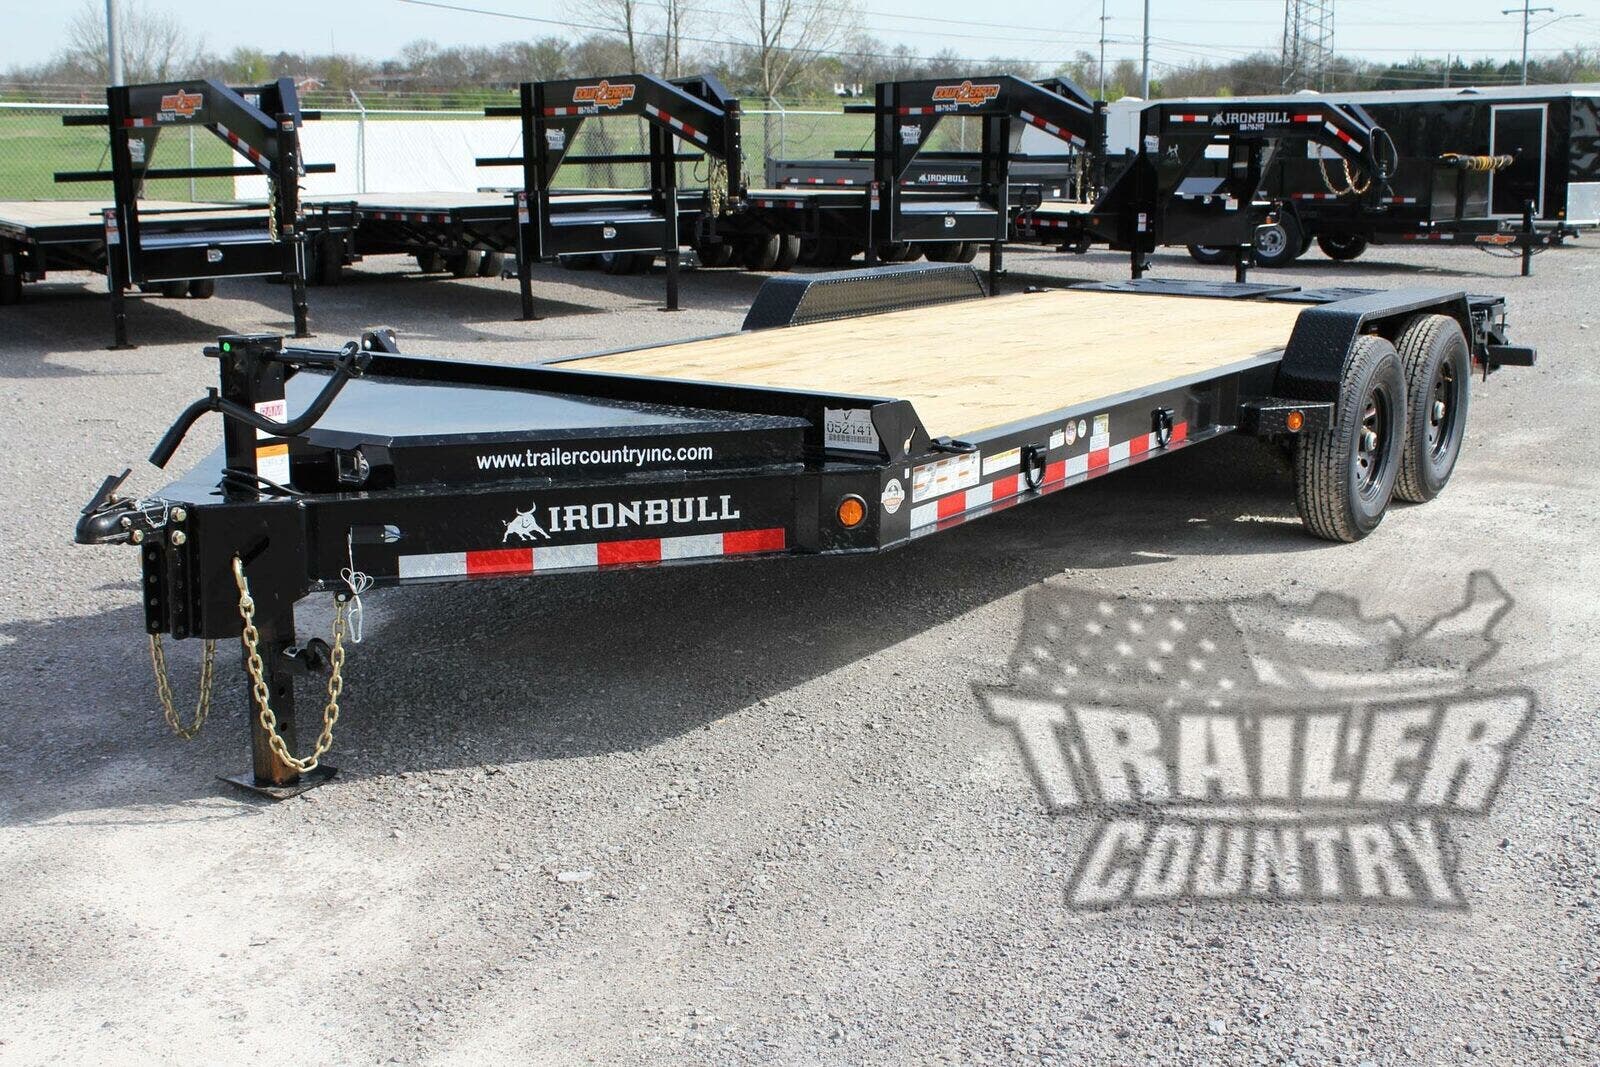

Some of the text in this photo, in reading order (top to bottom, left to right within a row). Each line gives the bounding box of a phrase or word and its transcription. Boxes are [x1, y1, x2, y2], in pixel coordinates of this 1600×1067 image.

[1226, 112, 1290, 123] IRONBULL
[927, 174, 968, 182] IRONBULL
[826, 420, 872, 436] 052141
[476, 446, 713, 470] www.trailercountryinc.com
[548, 494, 741, 533] IRONBULL
